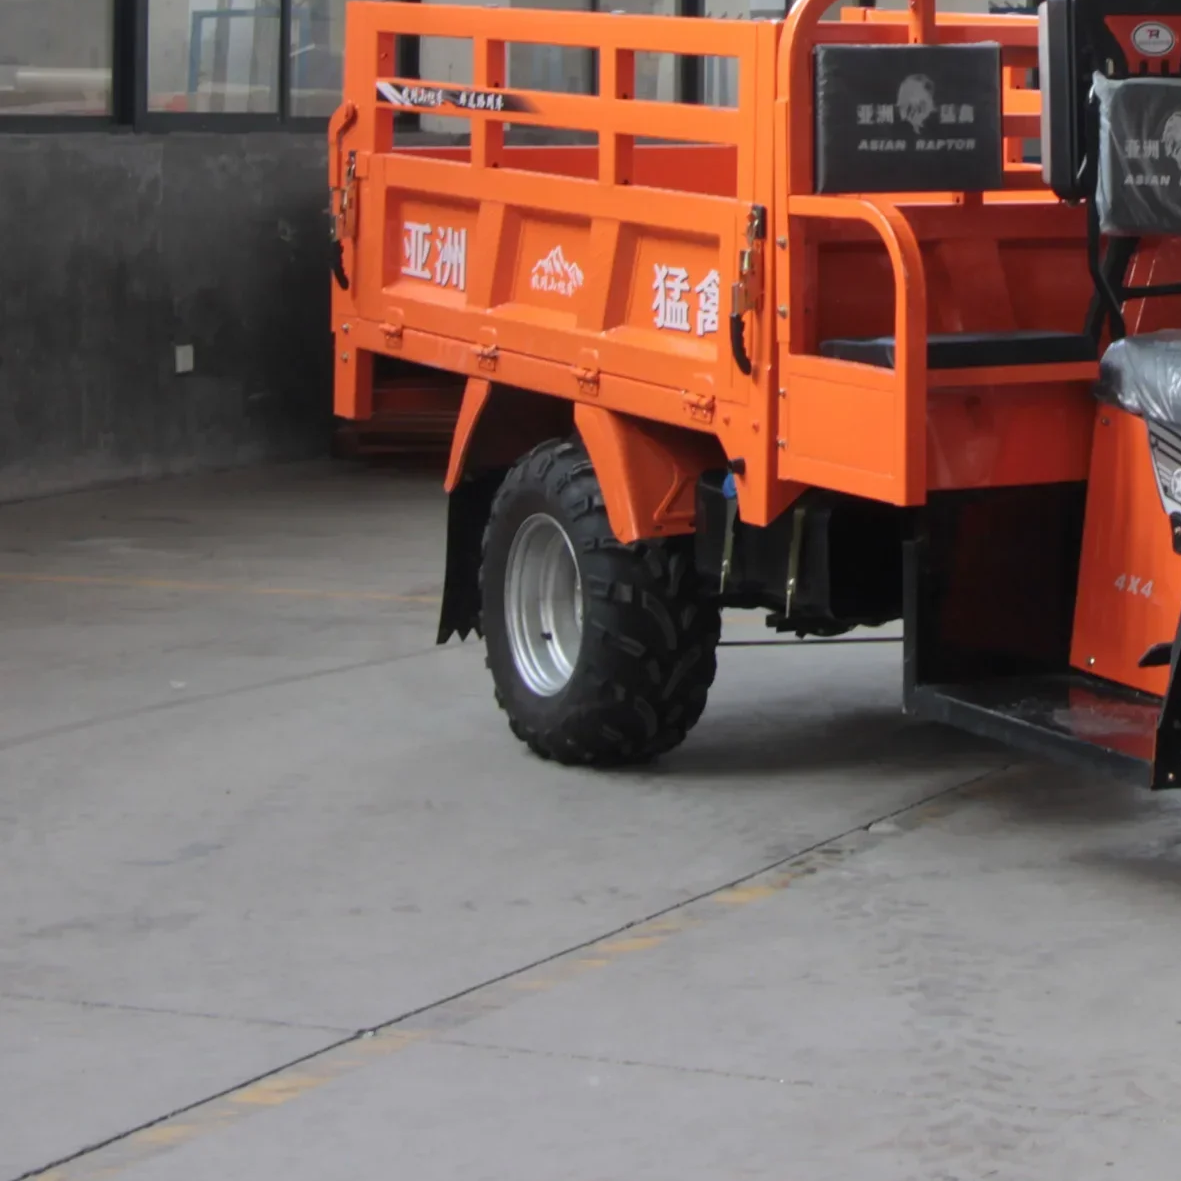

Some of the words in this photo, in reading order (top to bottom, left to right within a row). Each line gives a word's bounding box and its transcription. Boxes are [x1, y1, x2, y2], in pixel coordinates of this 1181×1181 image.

[857, 103, 894, 124] 亚洲
[858, 138, 906, 152] ASIAN
[915, 138, 976, 152] RAPTOR
[1123, 173, 1171, 187] ASIAN
[401, 221, 467, 292] 亚洲
[1114, 573, 1153, 598] 4X4
